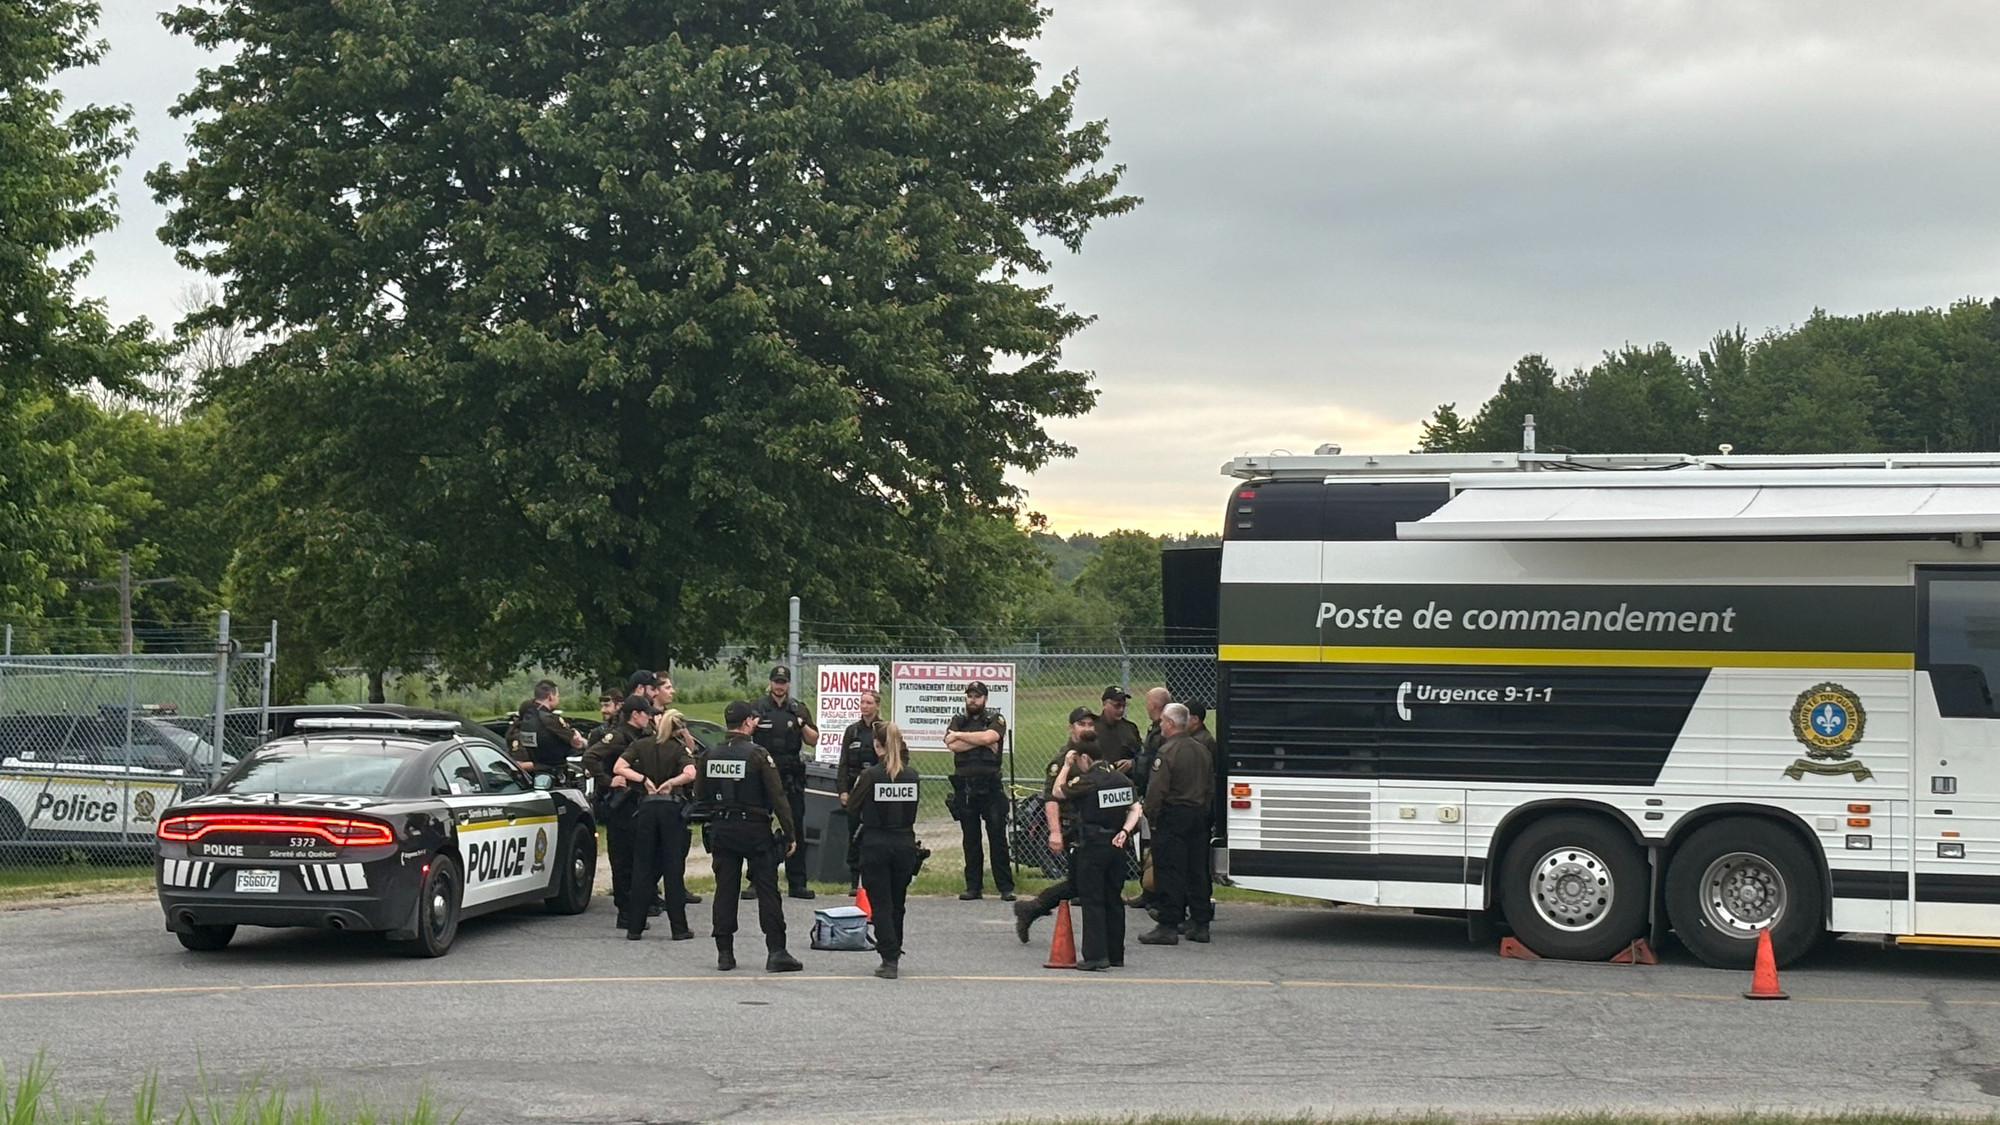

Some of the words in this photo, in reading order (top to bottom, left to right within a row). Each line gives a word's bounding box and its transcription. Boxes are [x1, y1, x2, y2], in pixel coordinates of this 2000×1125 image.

[1316, 602, 1402, 629] Poste
[1412, 601, 1452, 630] de
[1462, 603, 1736, 633] commandement
[898, 665, 1011, 678] ATTENTION
[821, 671, 876, 693] DANGER
[899, 683, 945, 692] STATIONNEMENT
[946, 682, 967, 692] RÉSERV
[1417, 685, 1498, 704] Urgence
[1504, 686, 1553, 702] 9-1-1
[821, 697, 860, 711] EXPLOS
[820, 733, 843, 746] EXPL
[1812, 734, 1846, 746] POLICE
[710, 763, 741, 775] POLICE
[880, 785, 913, 798] POLICE
[1103, 791, 1131, 804] POLICE
[34, 792, 118, 823] Police
[289, 838, 316, 847] 5373
[203, 844, 244, 856] POLICE
[269, 850, 294, 858] Sûreté
[296, 850, 306, 858] du
[308, 850, 337, 859] Québec
[467, 837, 528, 884] POLICE
